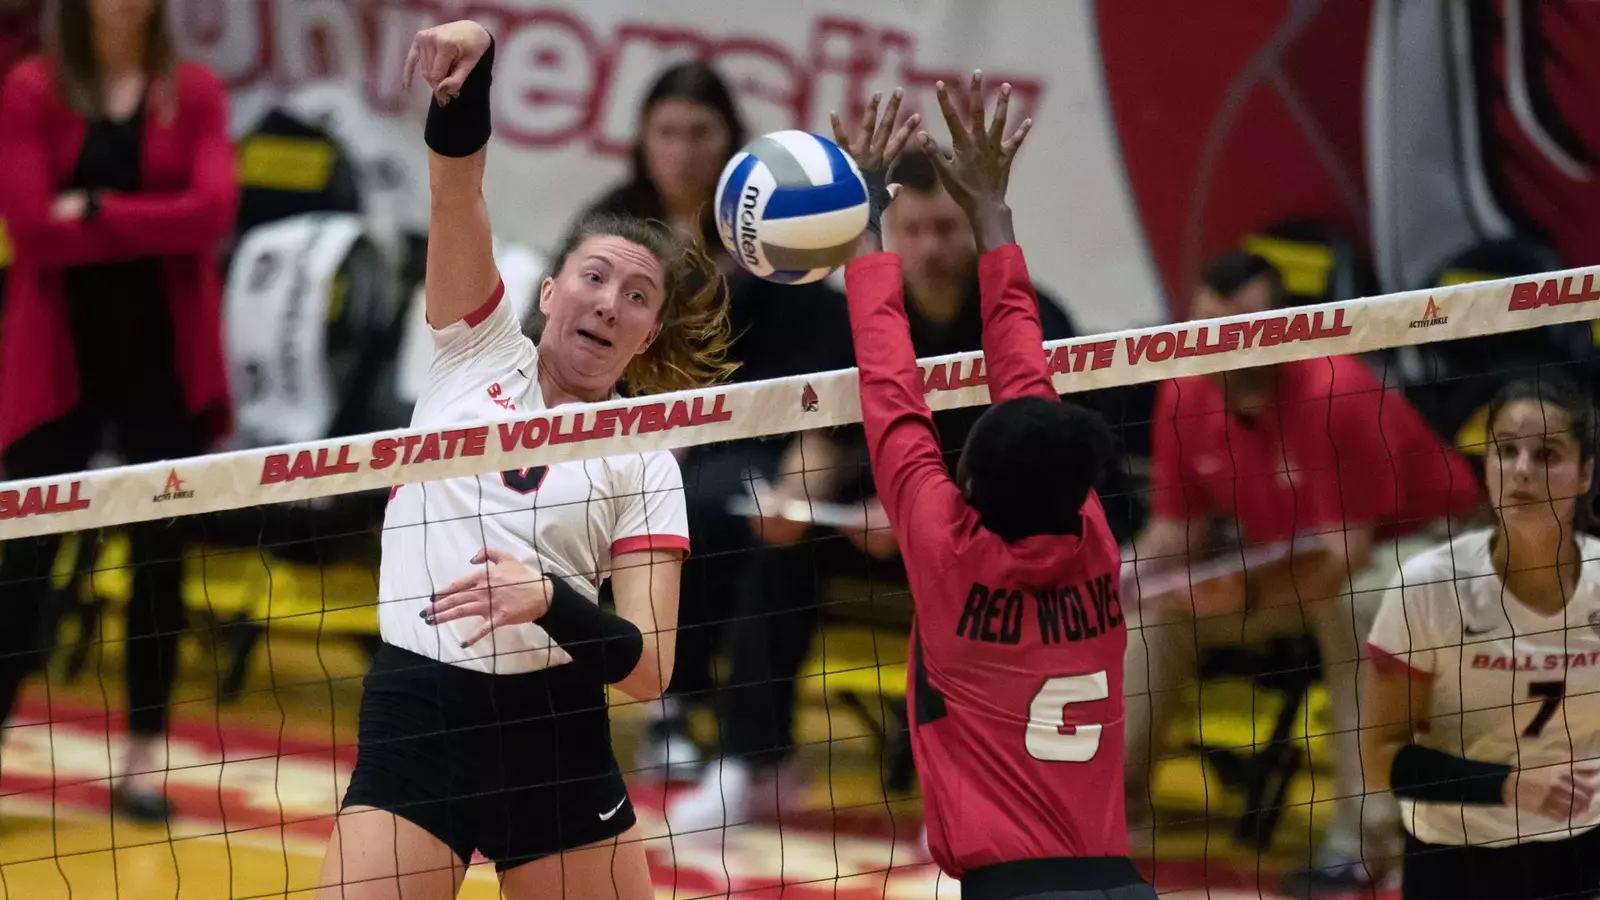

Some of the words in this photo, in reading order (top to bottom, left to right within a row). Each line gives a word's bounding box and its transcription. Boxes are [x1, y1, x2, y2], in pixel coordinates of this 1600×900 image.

[165, 0, 1044, 157] Uniersity
[741, 185, 761, 266] molten
[1430, 316, 1448, 326] ANKLE
[1508, 274, 1600, 311] BALL
[1042, 339, 1118, 376] ATE
[1126, 308, 1353, 366] VOLLEYBALL
[260, 445, 360, 485] BALL
[369, 426, 489, 470] STATE
[497, 393, 733, 452] VOLLEYBALL
[0, 481, 91, 519] BALL
[956, 581, 1024, 645] RED
[1471, 653, 1538, 672] BALL
[1521, 681, 1566, 738] 7
